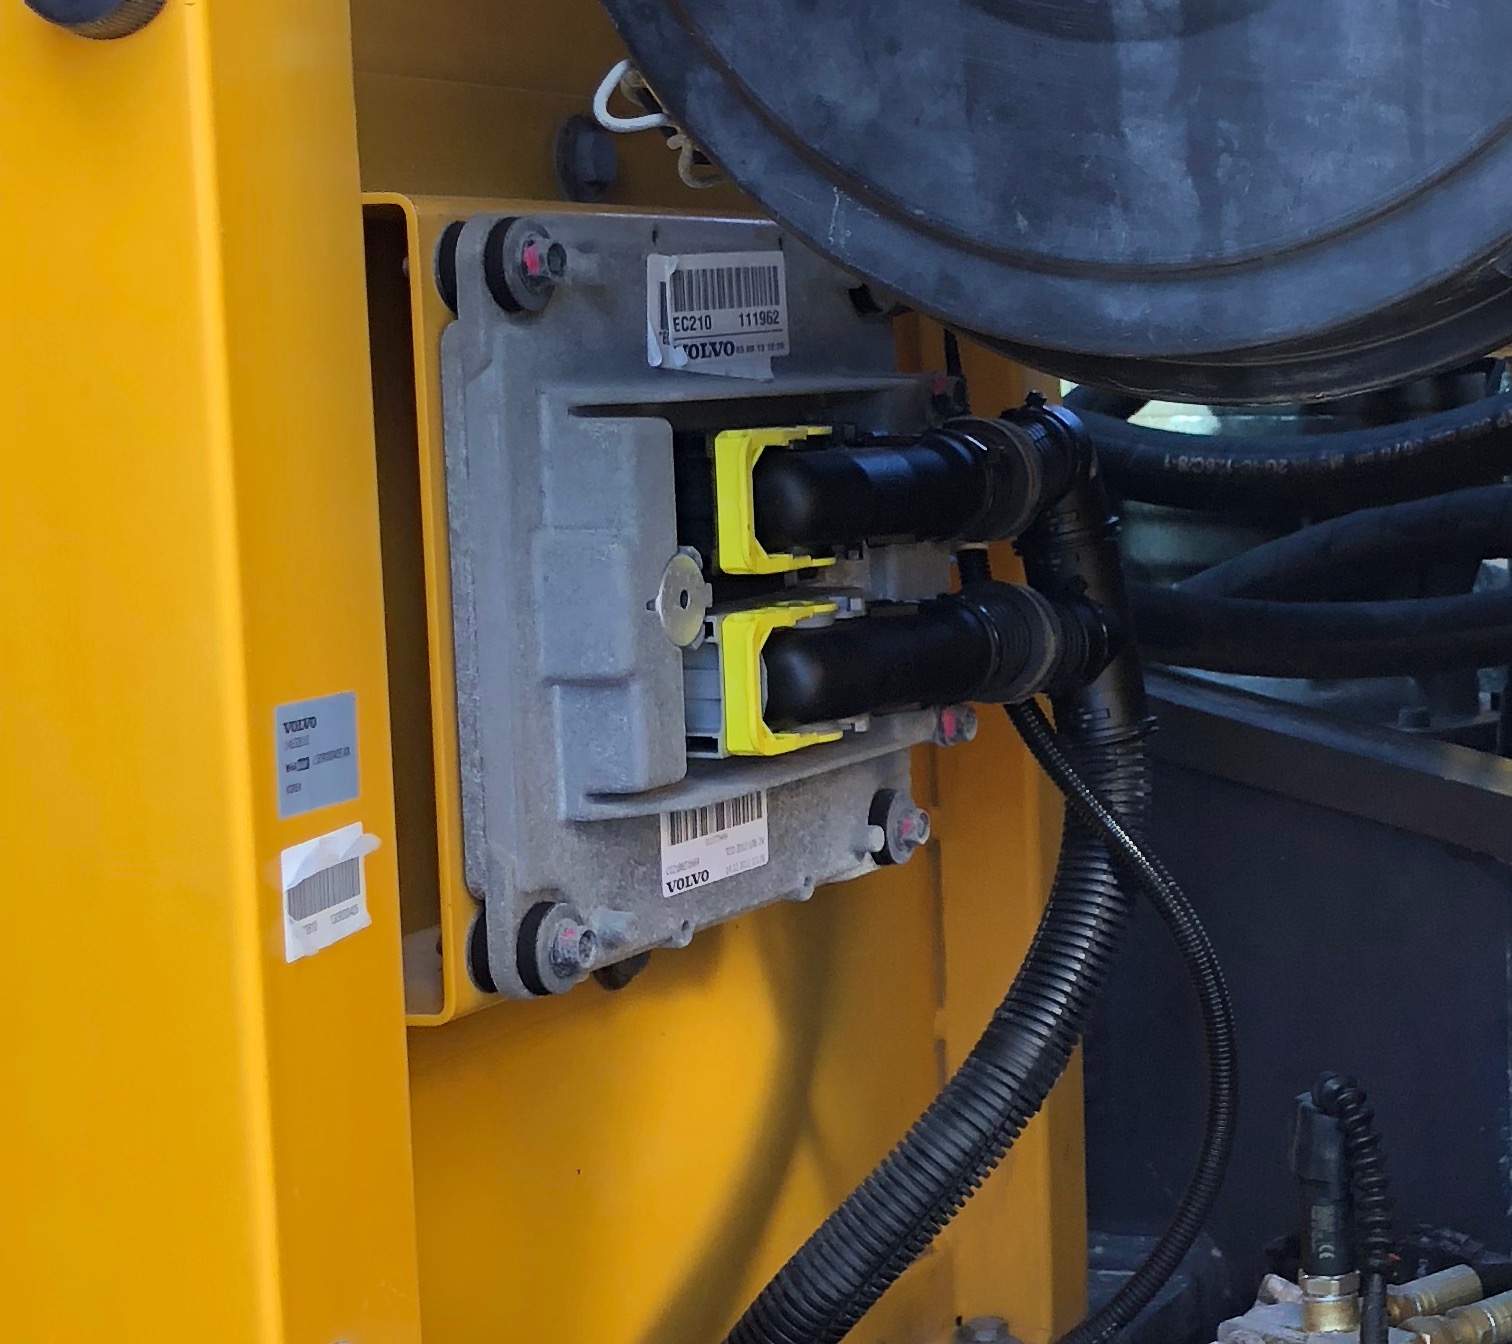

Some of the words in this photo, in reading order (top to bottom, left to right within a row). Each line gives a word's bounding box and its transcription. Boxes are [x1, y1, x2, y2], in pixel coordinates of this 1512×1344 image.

[672, 316, 712, 333] EC210
[739, 310, 780, 328] 111962
[666, 869, 710, 894] VOLVO
